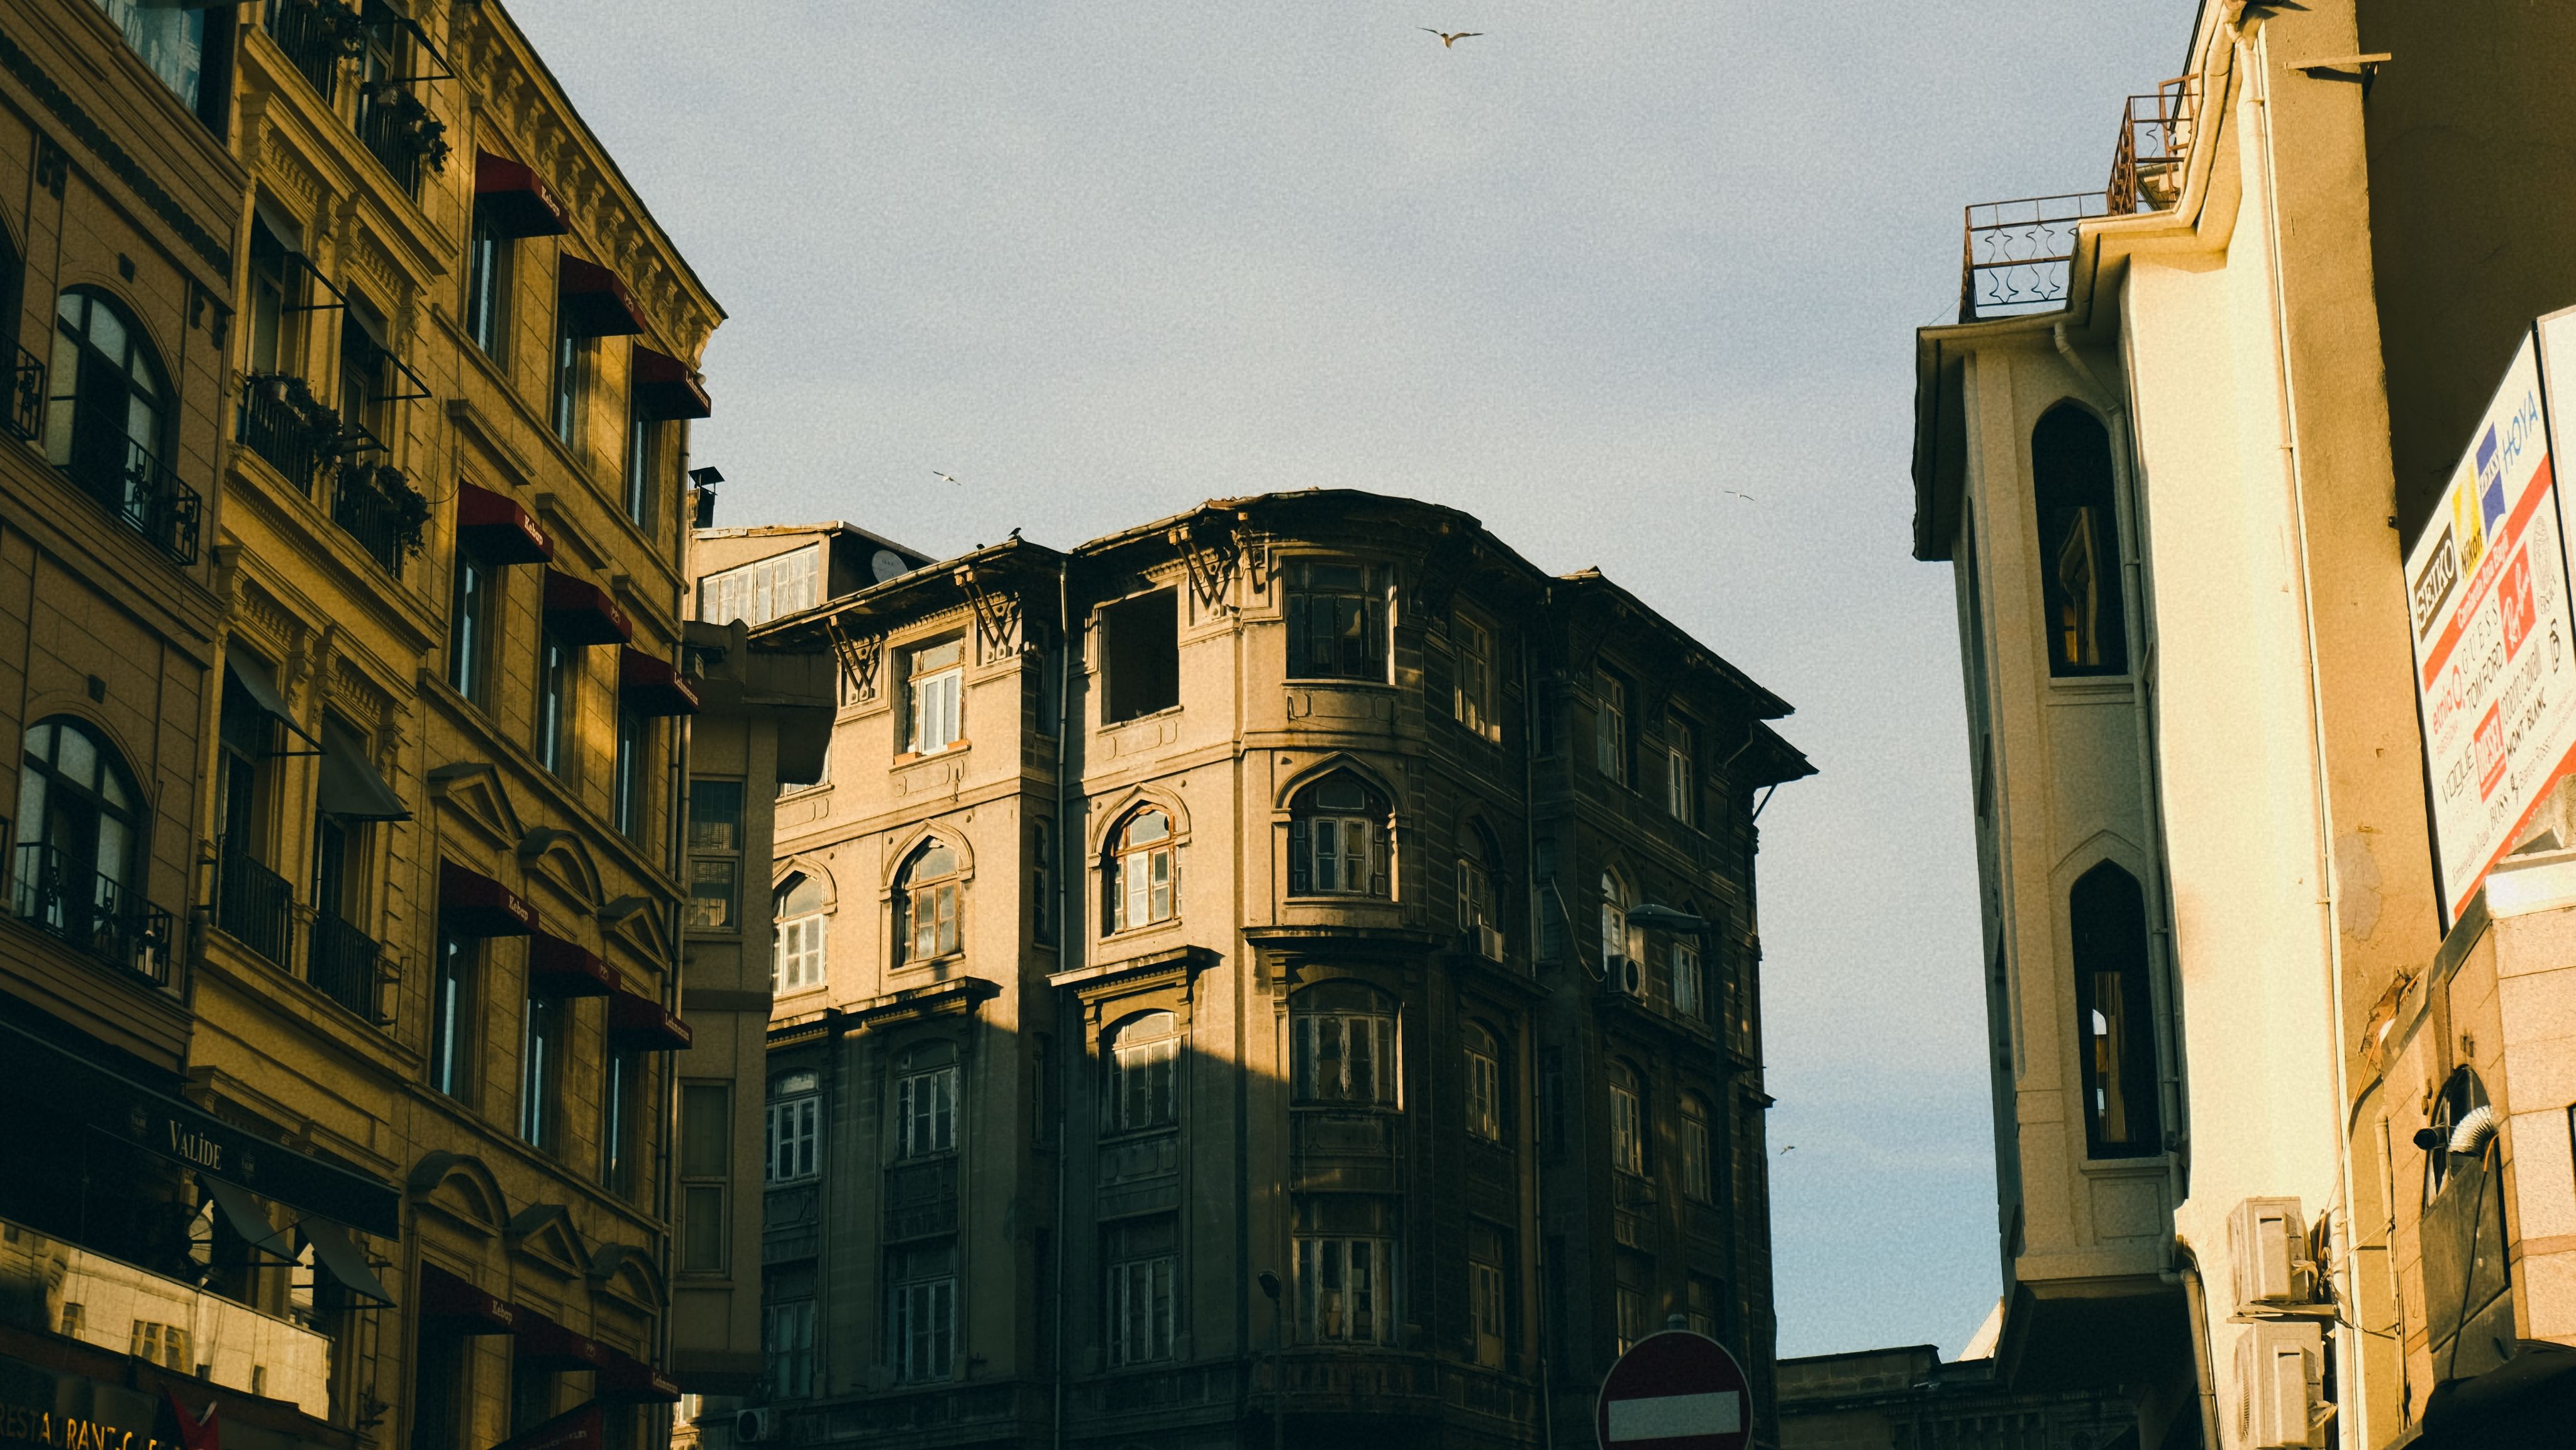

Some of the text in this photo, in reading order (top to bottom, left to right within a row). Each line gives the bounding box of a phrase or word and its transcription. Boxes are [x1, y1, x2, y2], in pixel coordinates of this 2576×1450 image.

[540, 185, 561, 218] Kebap
[685, 370, 709, 408] Lahmacun
[2502, 390, 2538, 475] HOYA
[523, 514, 544, 547] Kebap
[2461, 527, 2483, 579] Nikon
[2482, 559, 2495, 590] Ana
[2416, 539, 2455, 632] SEIKO
[2462, 598, 2498, 675] GUESS
[673, 671, 699, 705] Lahmacun
[2466, 640, 2503, 715] TOM FORD
[2501, 637, 2543, 730] roberto cavalli
[2433, 684, 2453, 735] etnia
[2506, 686, 2546, 762] MONT BLANC
[2475, 713, 2504, 784] DIESEL
[2489, 788, 2509, 831] BOSS
[508, 894, 529, 922] Kebap
[663, 1013, 690, 1042] Lahmacun
[492, 1299, 513, 1326] Kebap
[652, 1372, 679, 1395] Lahmacun
